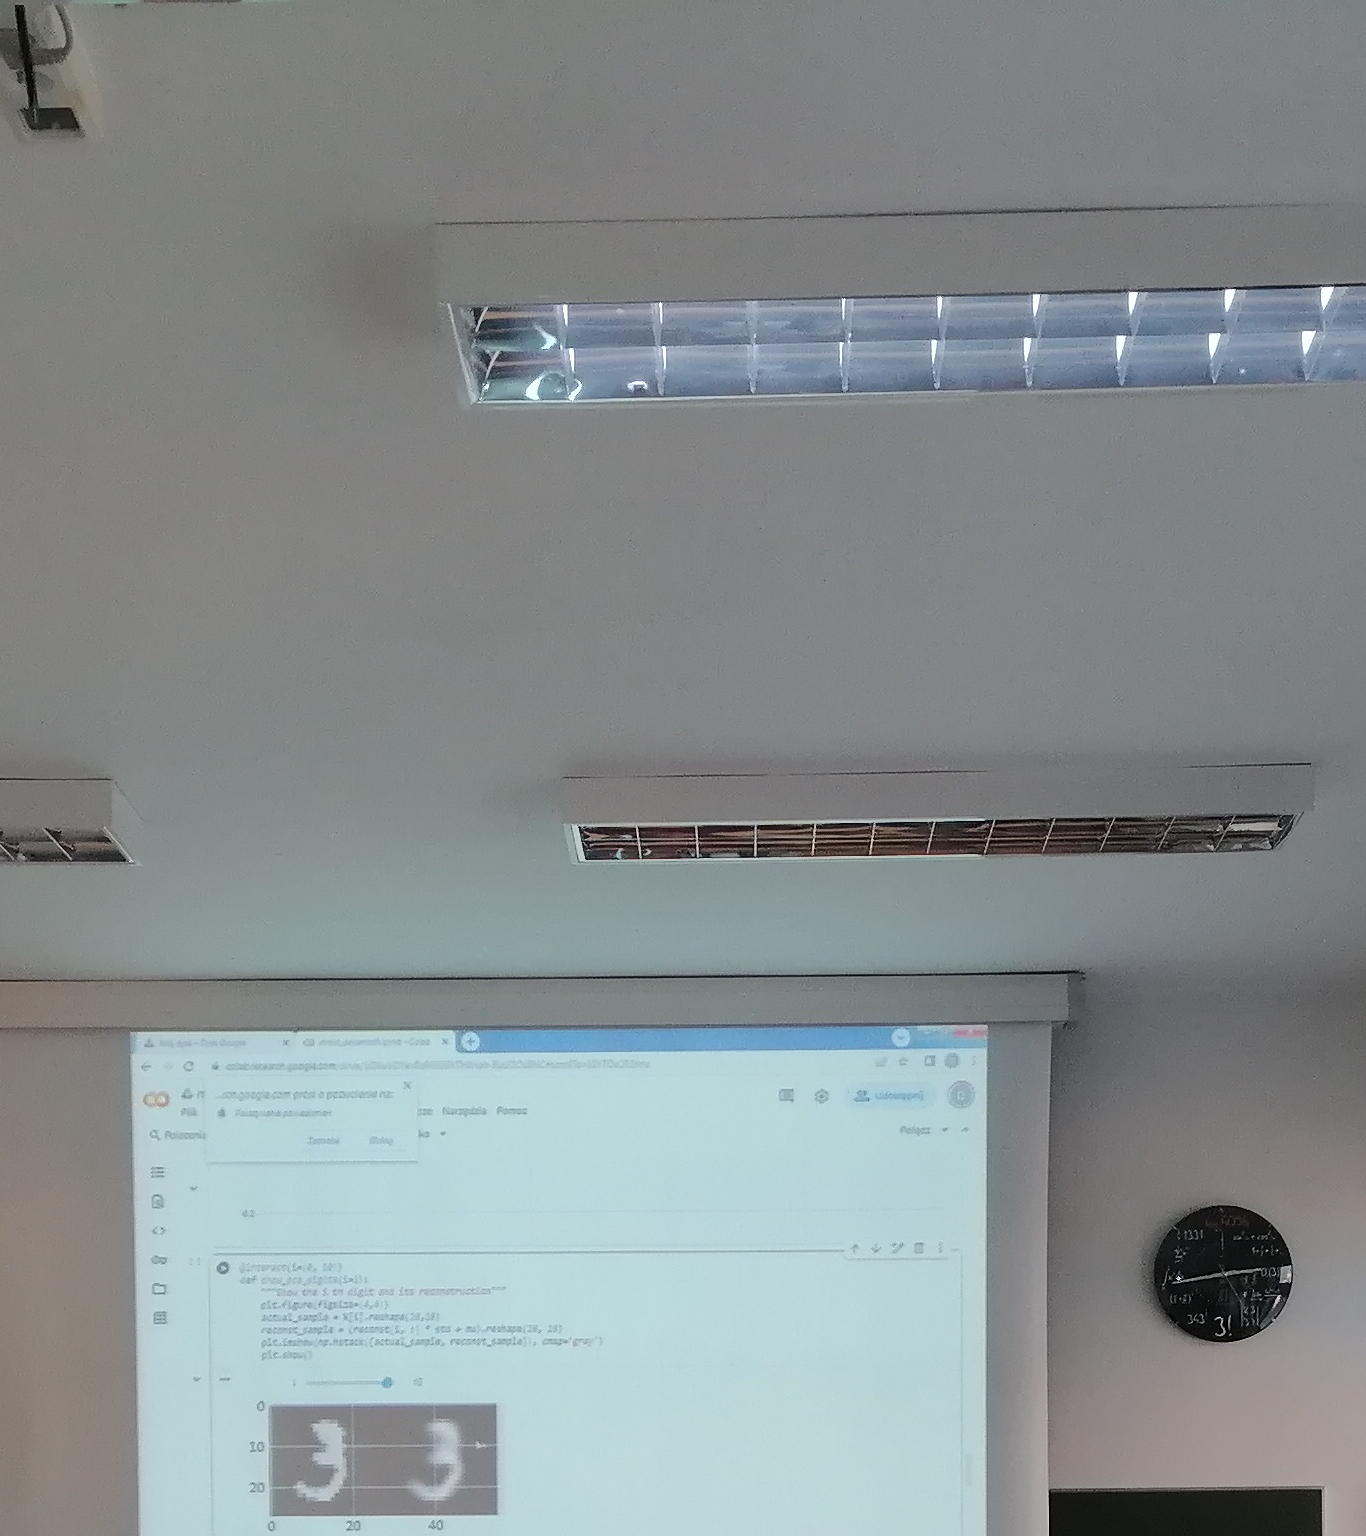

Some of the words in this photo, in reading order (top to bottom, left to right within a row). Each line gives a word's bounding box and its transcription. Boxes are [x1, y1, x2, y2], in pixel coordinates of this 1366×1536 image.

[249, 1441, 265, 1453] 10
[249, 1482, 265, 1494] 20
[267, 1520, 276, 1532] 0
[346, 1520, 361, 1532] 20
[428, 1520, 444, 1531] 40
